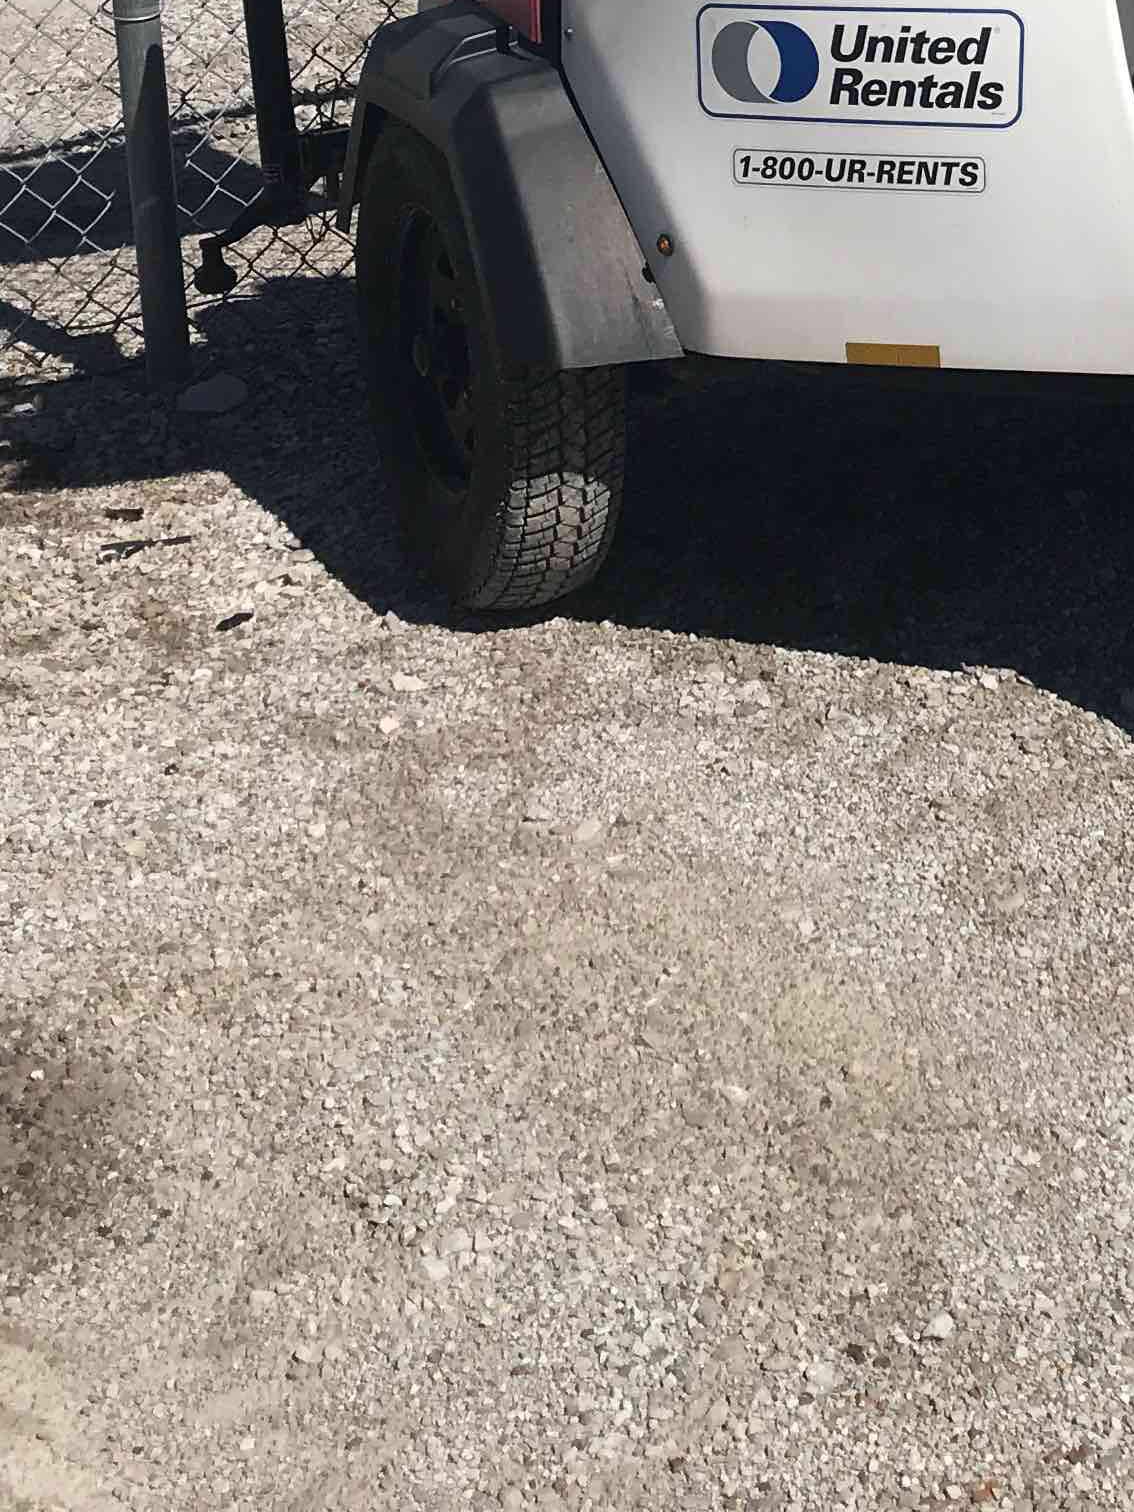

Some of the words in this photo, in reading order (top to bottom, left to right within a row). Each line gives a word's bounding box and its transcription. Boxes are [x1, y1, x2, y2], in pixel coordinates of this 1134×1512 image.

[829, 24, 992, 66] United
[829, 67, 1005, 110] Rentals
[738, 154, 981, 187] 1-800-UR-RENTS
